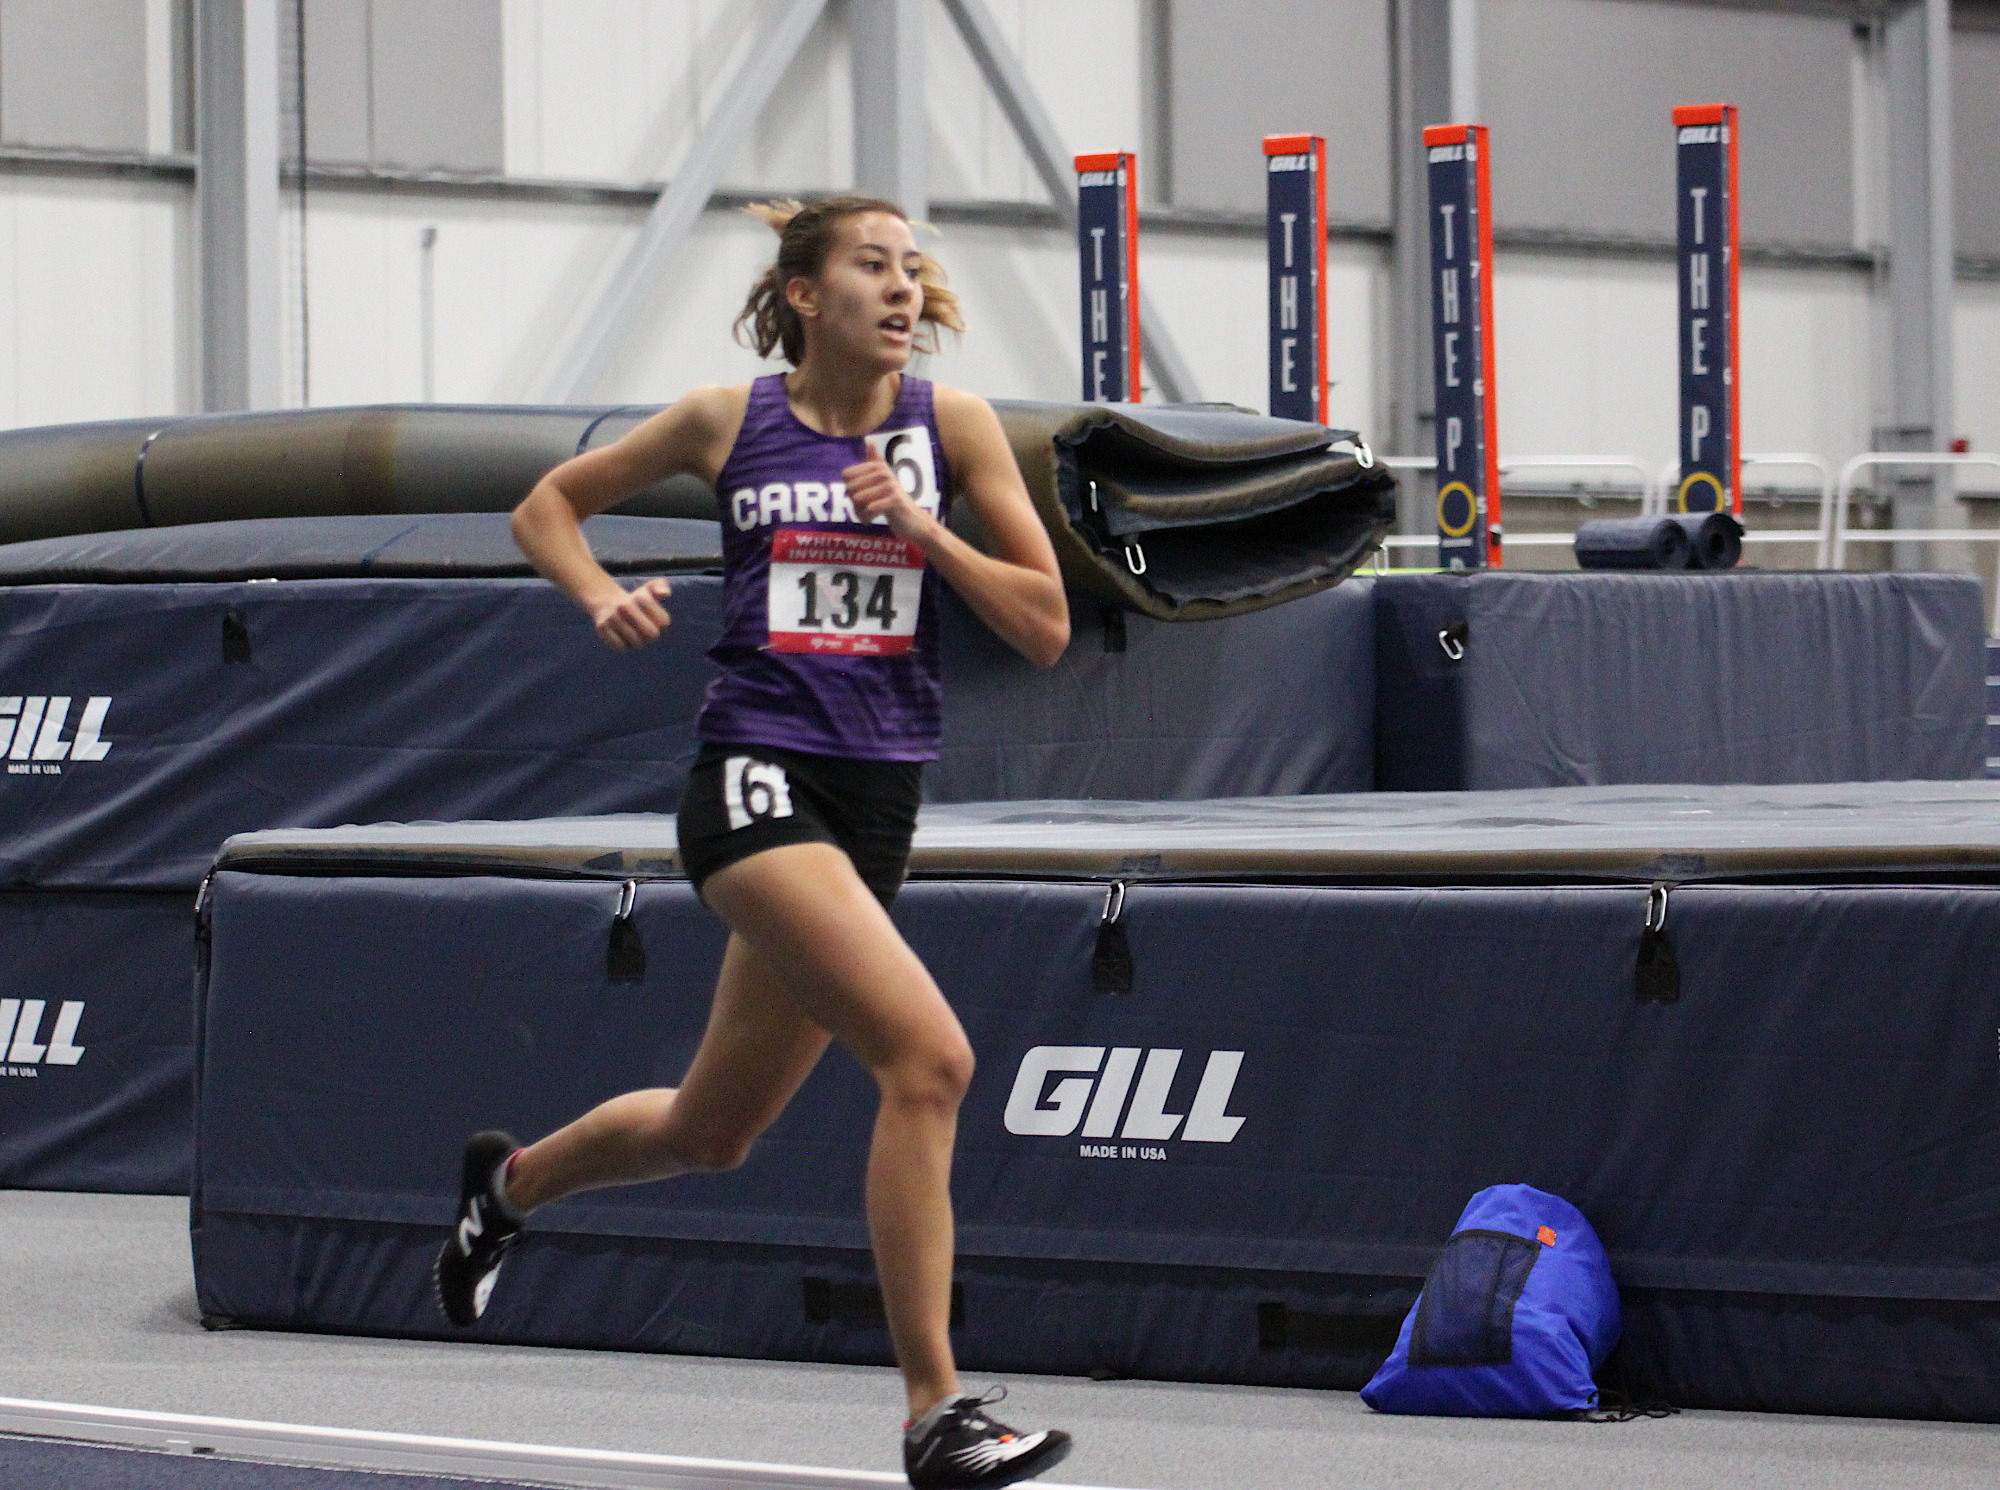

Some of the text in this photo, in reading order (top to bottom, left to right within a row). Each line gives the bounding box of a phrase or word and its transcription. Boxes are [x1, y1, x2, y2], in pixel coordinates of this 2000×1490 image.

[1440, 204, 1461, 388] THE
[1469, 260, 1480, 279] 7
[1690, 187, 1710, 376] THE
[1090, 227, 1108, 402] THE
[1279, 213, 1299, 393] THE
[885, 434, 924, 501] 6
[731, 481, 945, 533] CARR
[788, 549, 909, 565] INVITATIONAL
[796, 534, 907, 552] WHITWORTH
[797, 571, 897, 631] 134
[7, 764, 62, 775] MADE IN USA
[740, 759, 777, 822] 6
[1003, 1045, 1247, 1143] GILL
[1079, 1144, 1167, 1160] MADE IN USA
